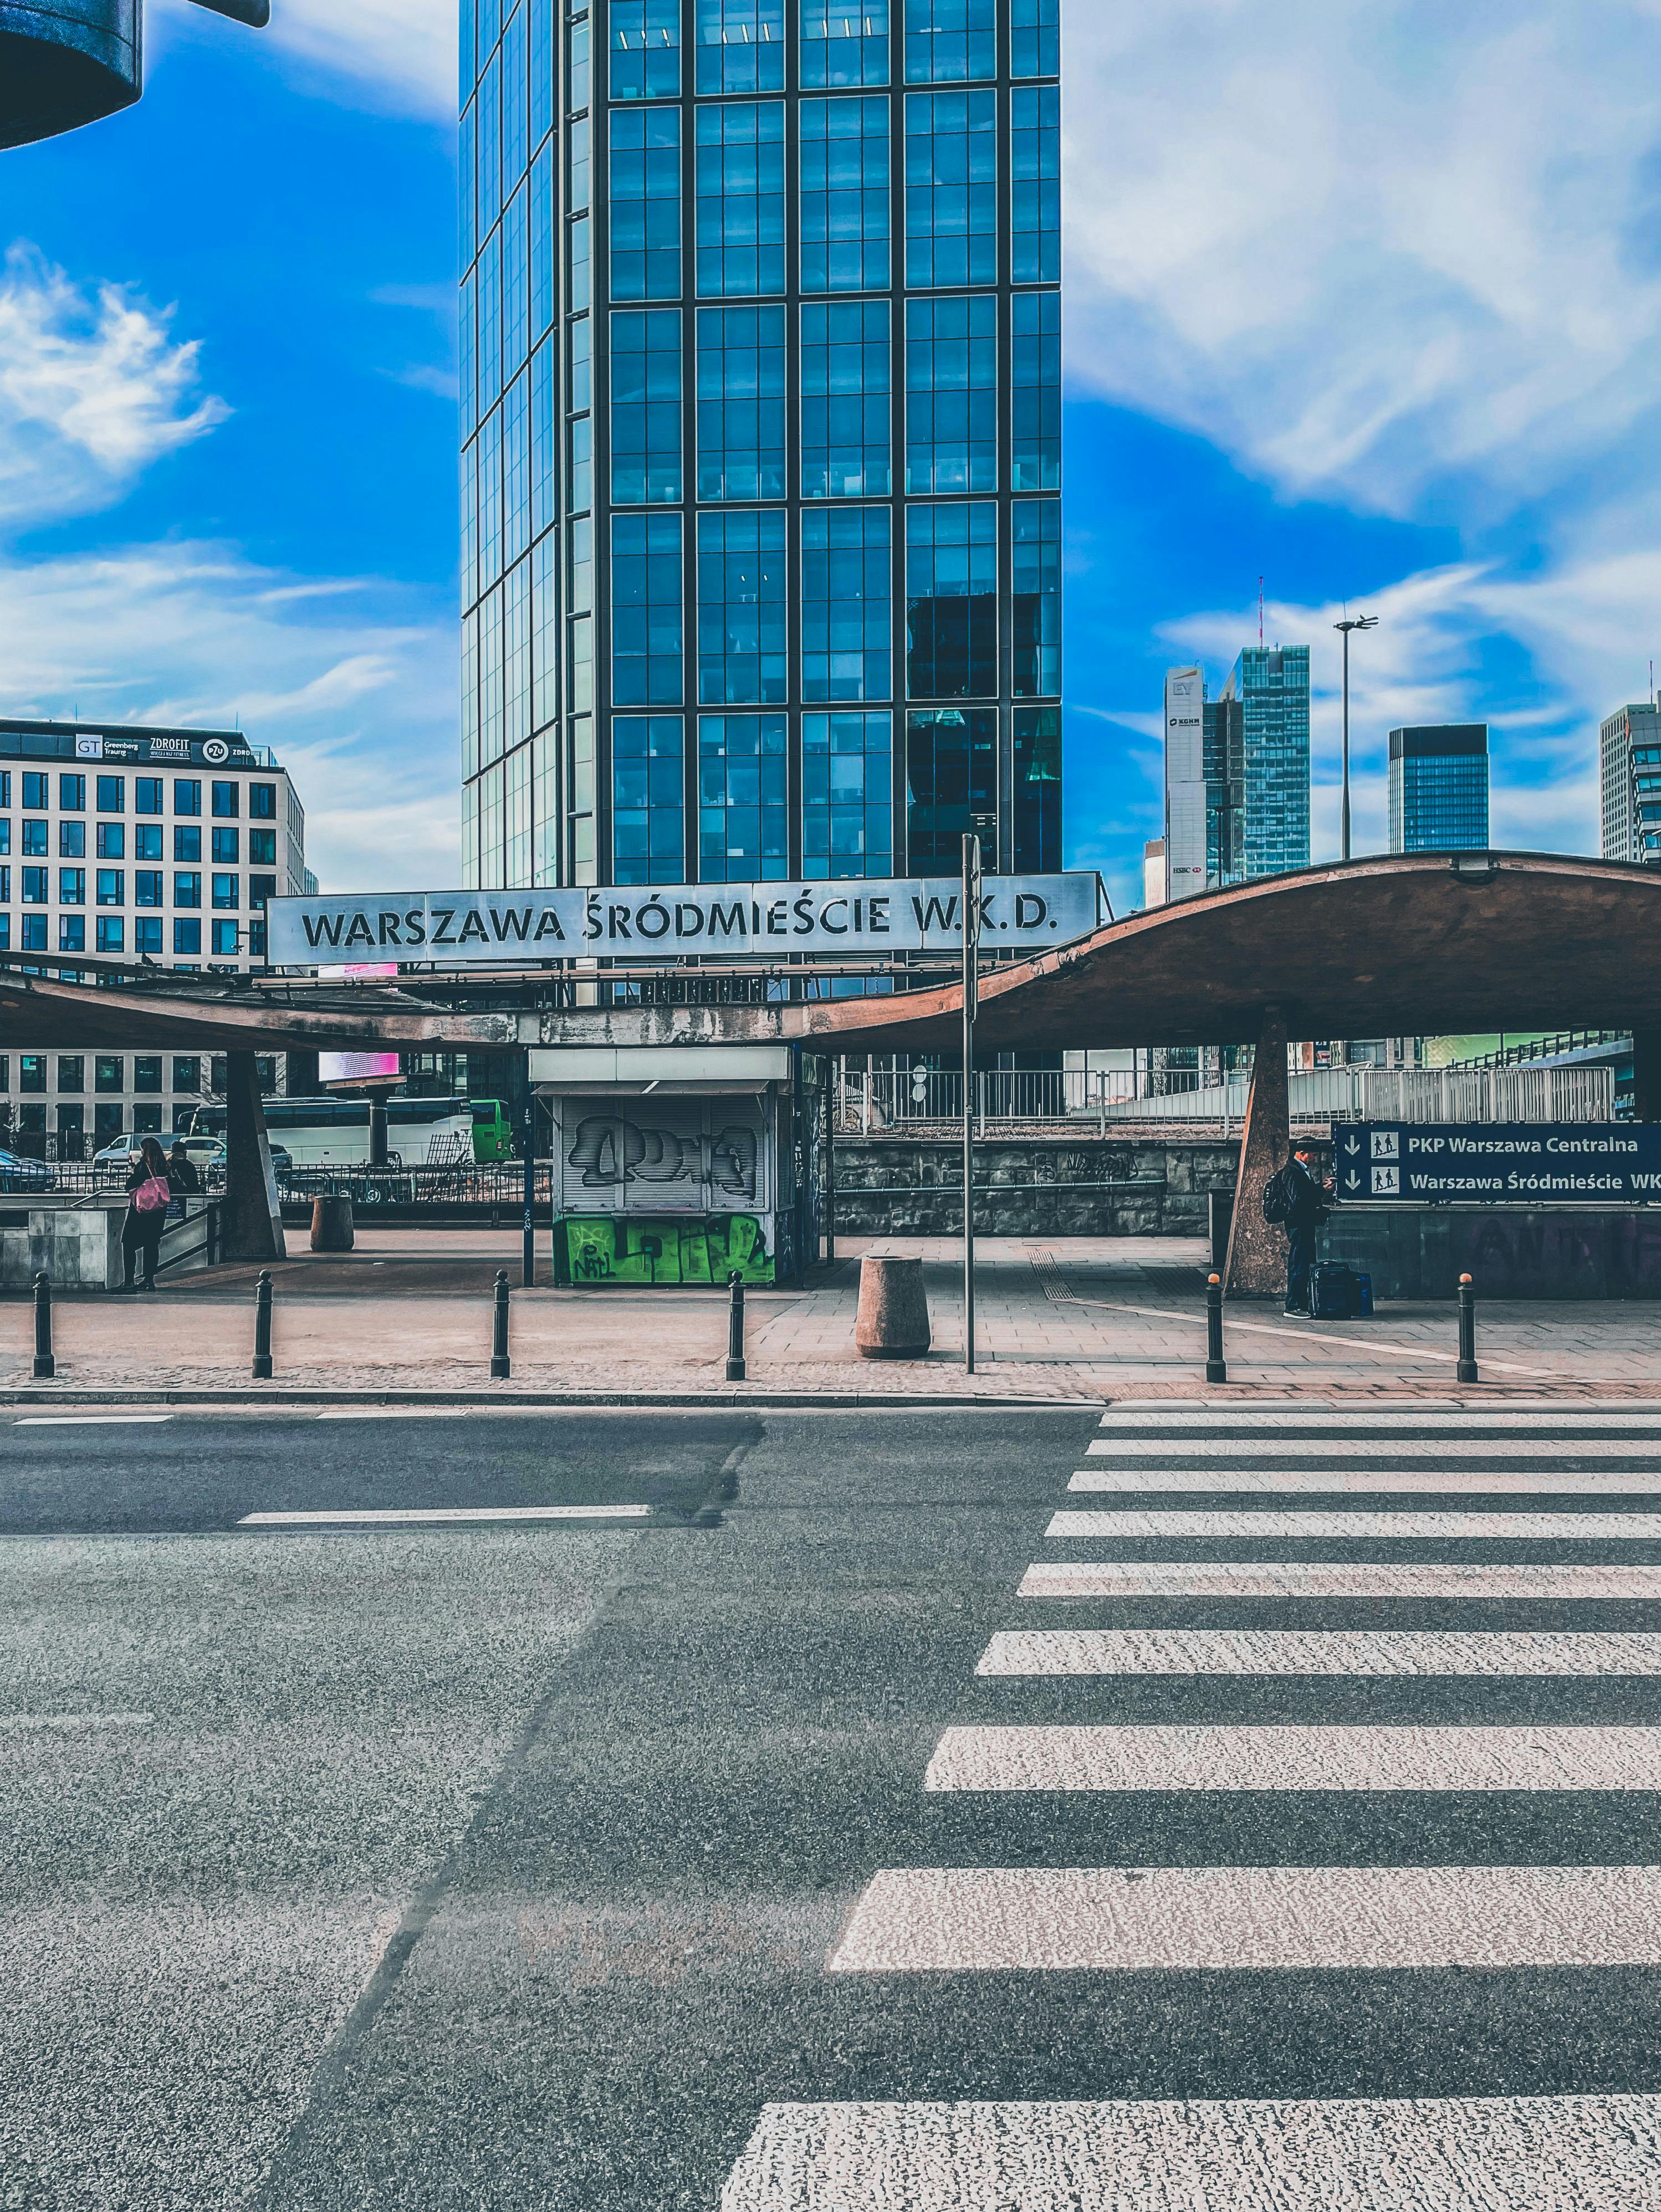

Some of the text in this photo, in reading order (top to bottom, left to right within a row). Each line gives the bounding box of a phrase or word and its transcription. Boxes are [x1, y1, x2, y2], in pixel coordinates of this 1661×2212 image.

[1173, 682, 1194, 695] EY
[78, 740, 100, 753] GT
[104, 741, 139, 750] Greenberg
[150, 738, 189, 750] ZDROFIT
[208, 745, 223, 756] PZU
[302, 889, 1057, 947] WARSZAWA ŚRÓDMIEŚCIE W.K.D.
[1409, 1136, 1638, 1153] PKP Warszawa Centralna
[1410, 1174, 1502, 1189] Warszawa
[1507, 1171, 1623, 1189] Śródmieście
